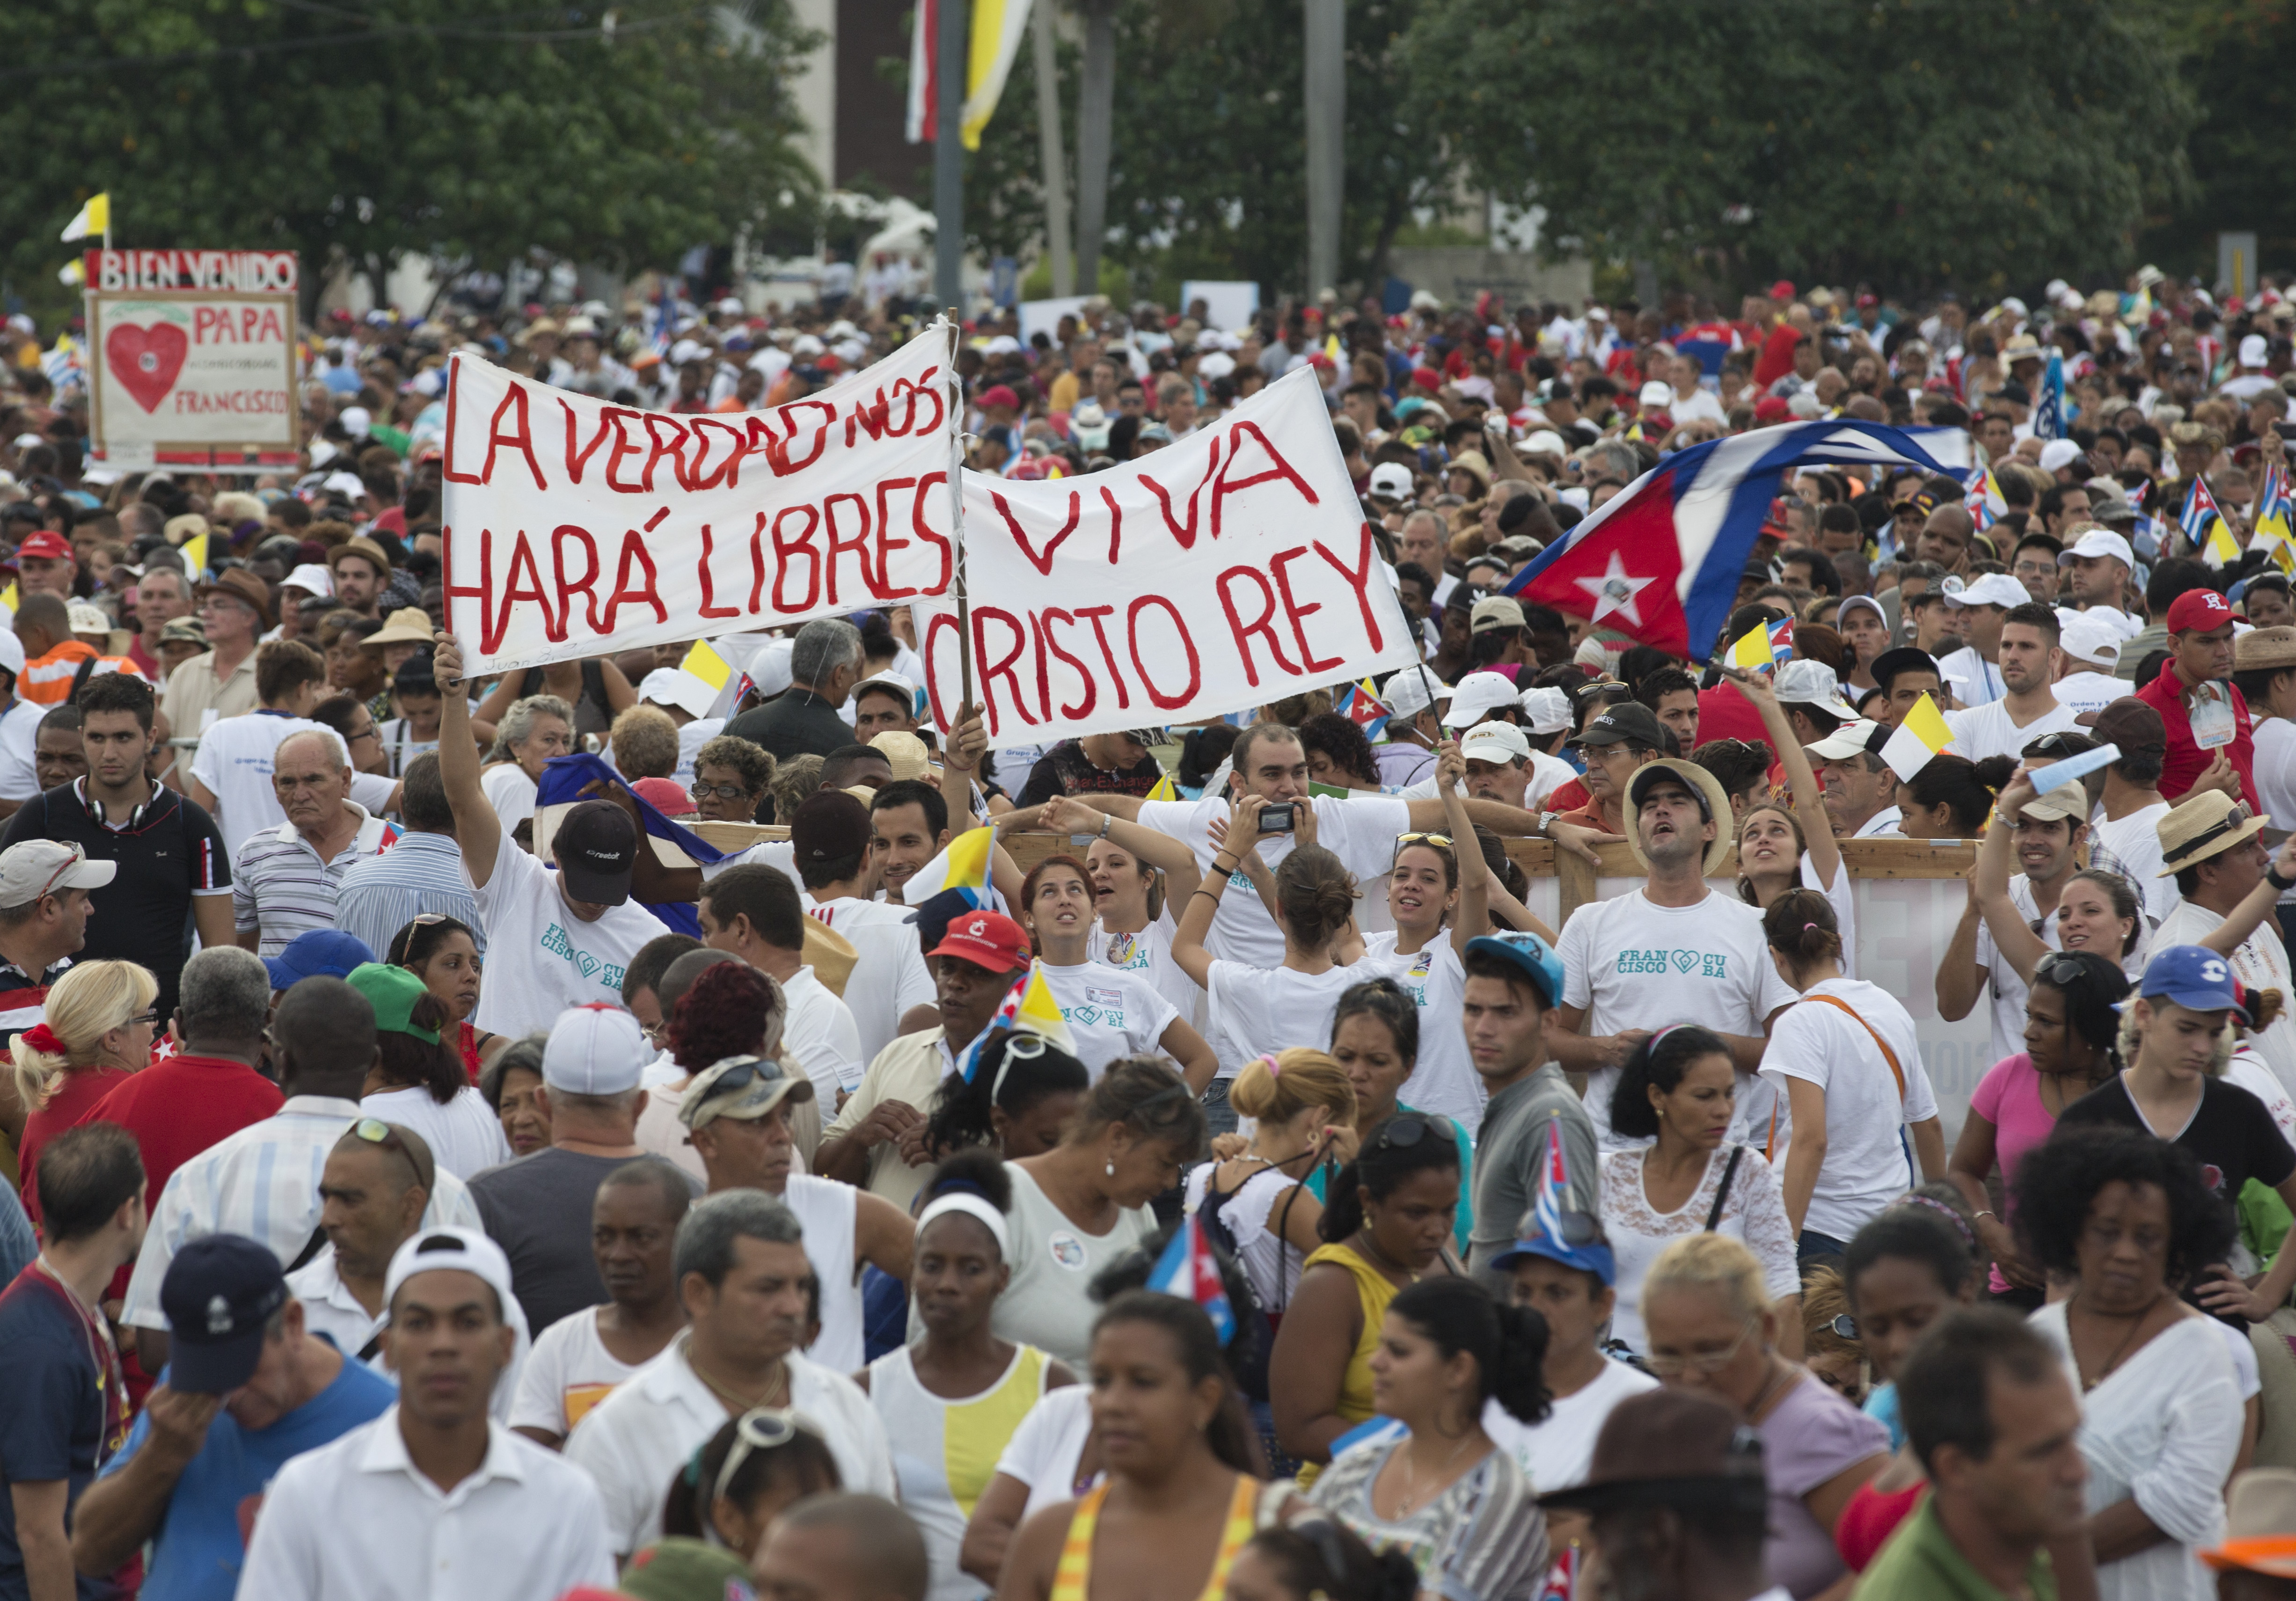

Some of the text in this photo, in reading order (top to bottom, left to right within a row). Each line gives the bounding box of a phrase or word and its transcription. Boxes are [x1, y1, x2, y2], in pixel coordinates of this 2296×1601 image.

[193, 307, 284, 344] PAPA
[175, 390, 290, 415] FRANCISCO
[443, 357, 548, 491] LA
[556, 400, 837, 494] VERDAD
[987, 420, 1320, 576] VIVA
[443, 471, 953, 655] HARÁ LIBRES
[925, 521, 1384, 738] CRISTO REY
[485, 657, 530, 670] Juan
[1097, 775, 1155, 789] Exchange
[1618, 950, 1727, 966] FRAN CU
[604, 963, 625, 979] CU
[1617, 961, 1726, 978] CISCO BA
[600, 973, 622, 991] BA
[1104, 1010, 1124, 1020] CU
[1107, 1017, 1128, 1029] BA
